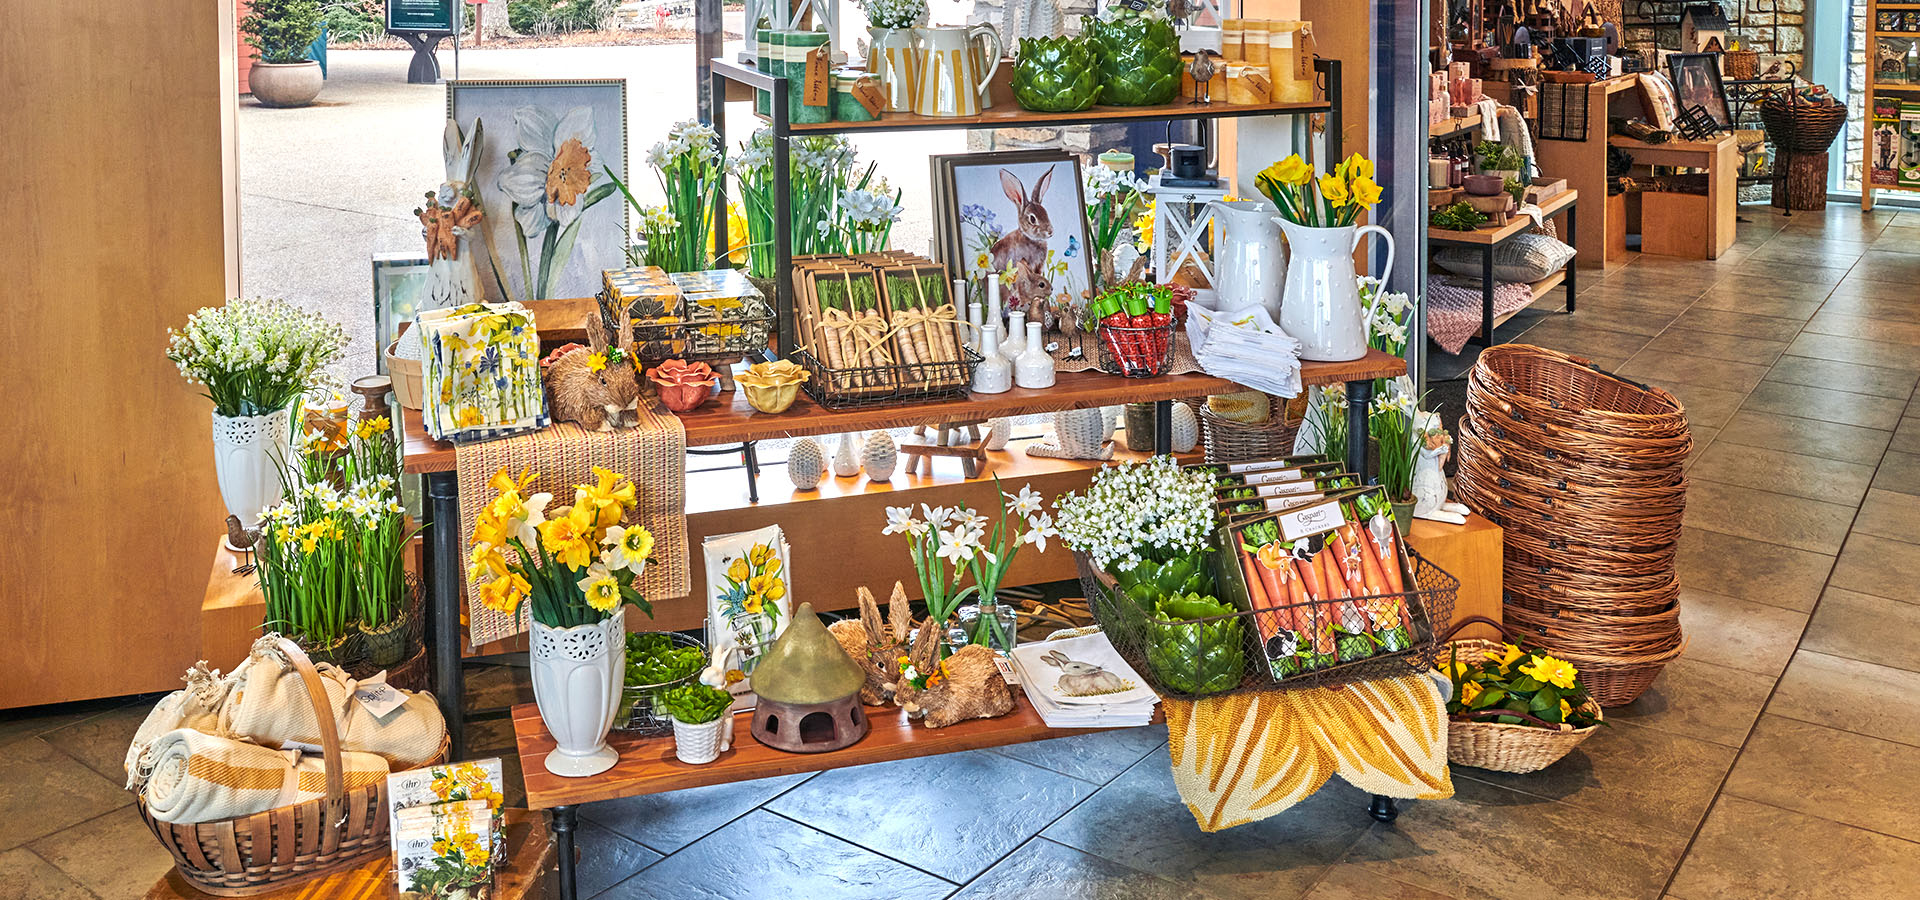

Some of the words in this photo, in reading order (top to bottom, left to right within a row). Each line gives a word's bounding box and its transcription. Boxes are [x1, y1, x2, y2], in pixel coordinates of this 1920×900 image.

[1297, 509, 1327, 527] Caspari
[405, 779, 418, 789] ihr
[412, 839, 425, 848] ihr
